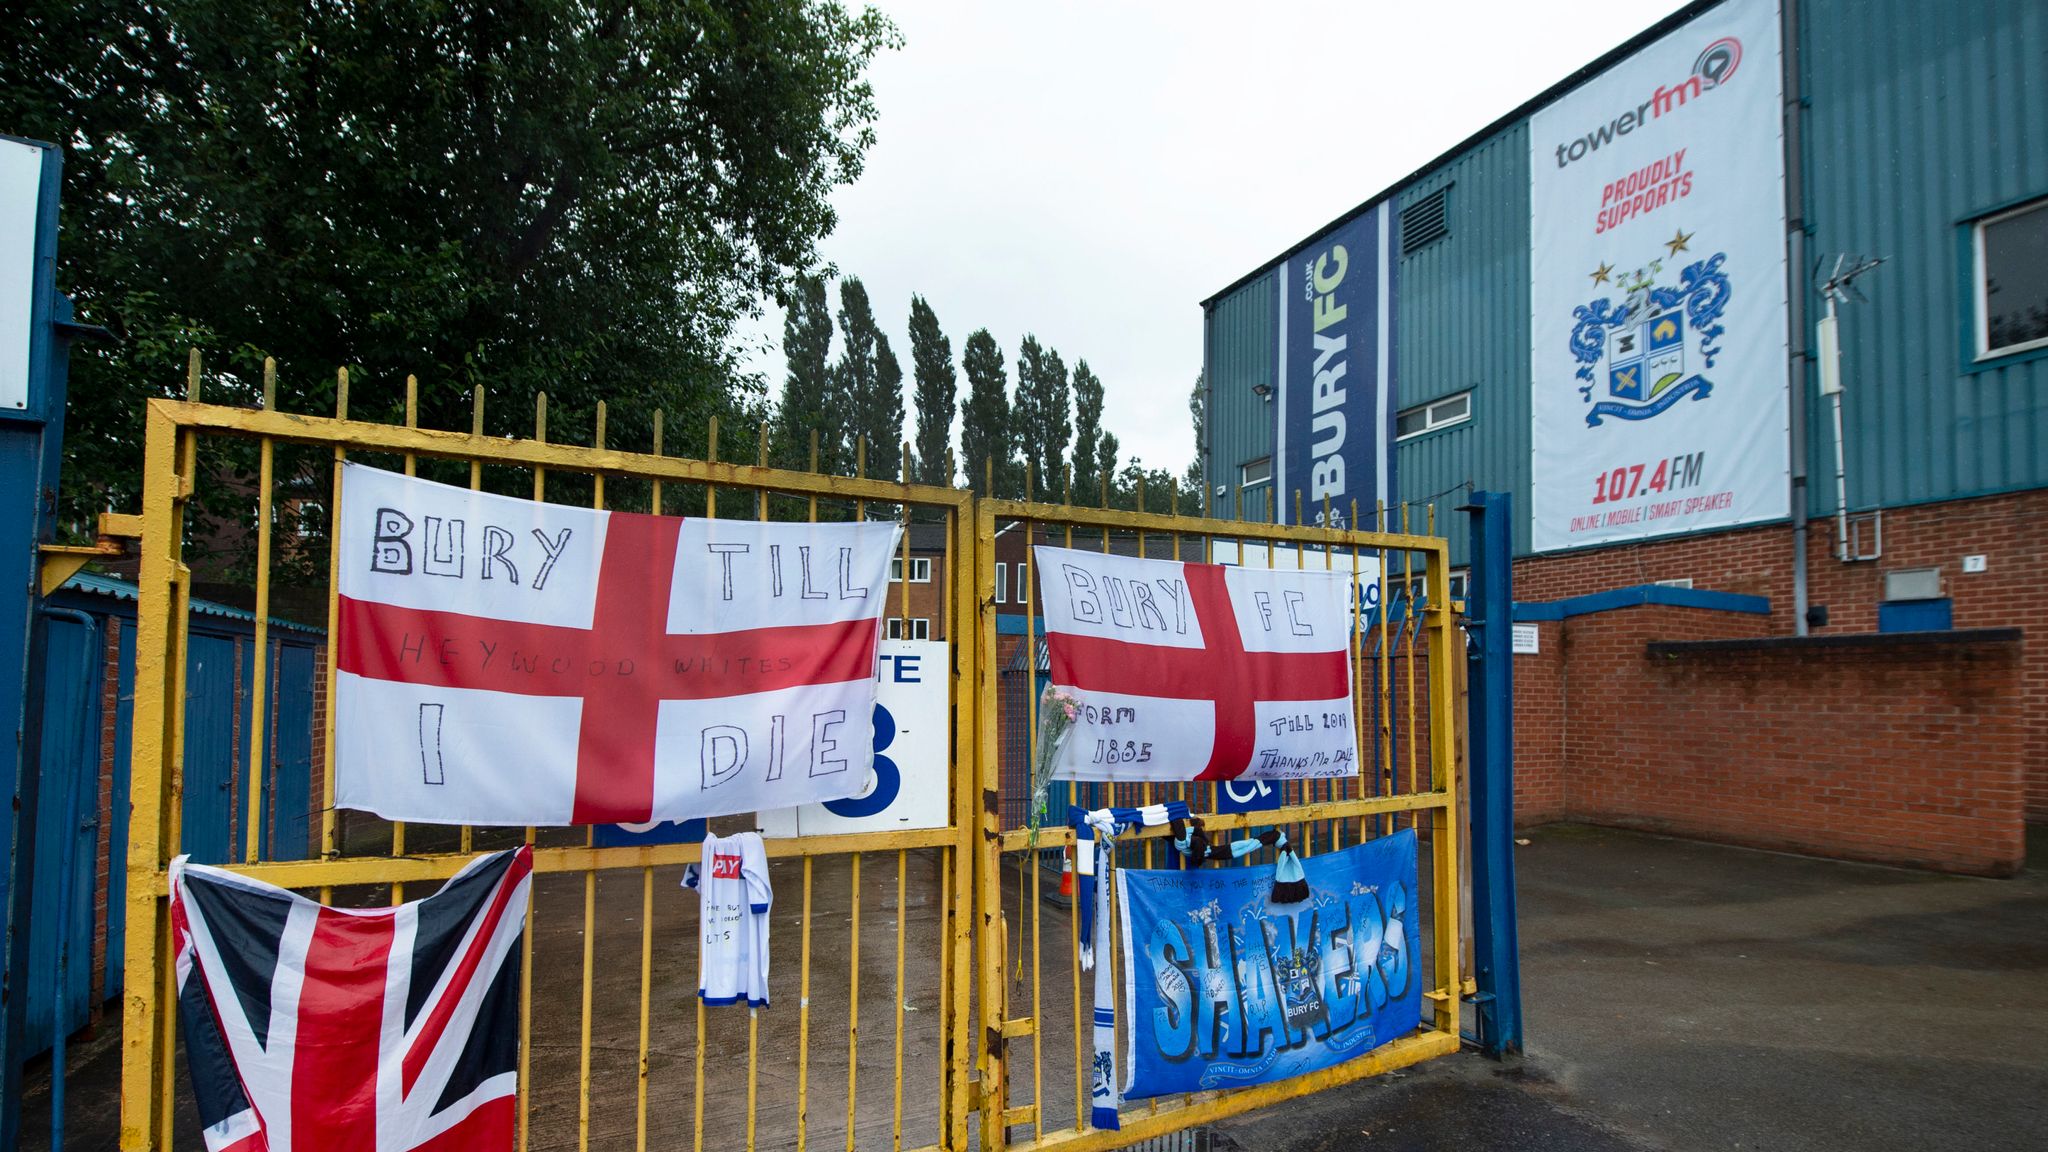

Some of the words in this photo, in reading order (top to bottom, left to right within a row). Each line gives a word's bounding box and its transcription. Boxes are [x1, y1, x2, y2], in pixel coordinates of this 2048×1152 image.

[1555, 75, 1701, 168] towerfm
[1596, 170, 1694, 234] SUPPORTS
[1601, 148, 1687, 208] PROUDLY
[1570, 513, 1600, 532] ONLINE
[1607, 506, 1641, 526] MOBILE
[1648, 499, 1683, 520] SMART
[1684, 491, 1733, 515] SPEAKER
[371, 507, 572, 590] BURY
[707, 543, 868, 600] TILL
[1061, 563, 1187, 635] BURY
[1254, 591, 1313, 636] FC
[400, 633, 635, 676] HEYWOOD
[675, 657, 792, 675] WHITES
[418, 703, 445, 786] I
[701, 710, 848, 791] DIE
[1322, 712, 1347, 729] 2019
[1092, 739, 1153, 764] 1885
[1260, 748, 1309, 769] THANKS
[1150, 880, 1409, 1060] SHAKERS
[1287, 1004, 1308, 1018] BURY
[1309, 1000, 1320, 1010] FC
